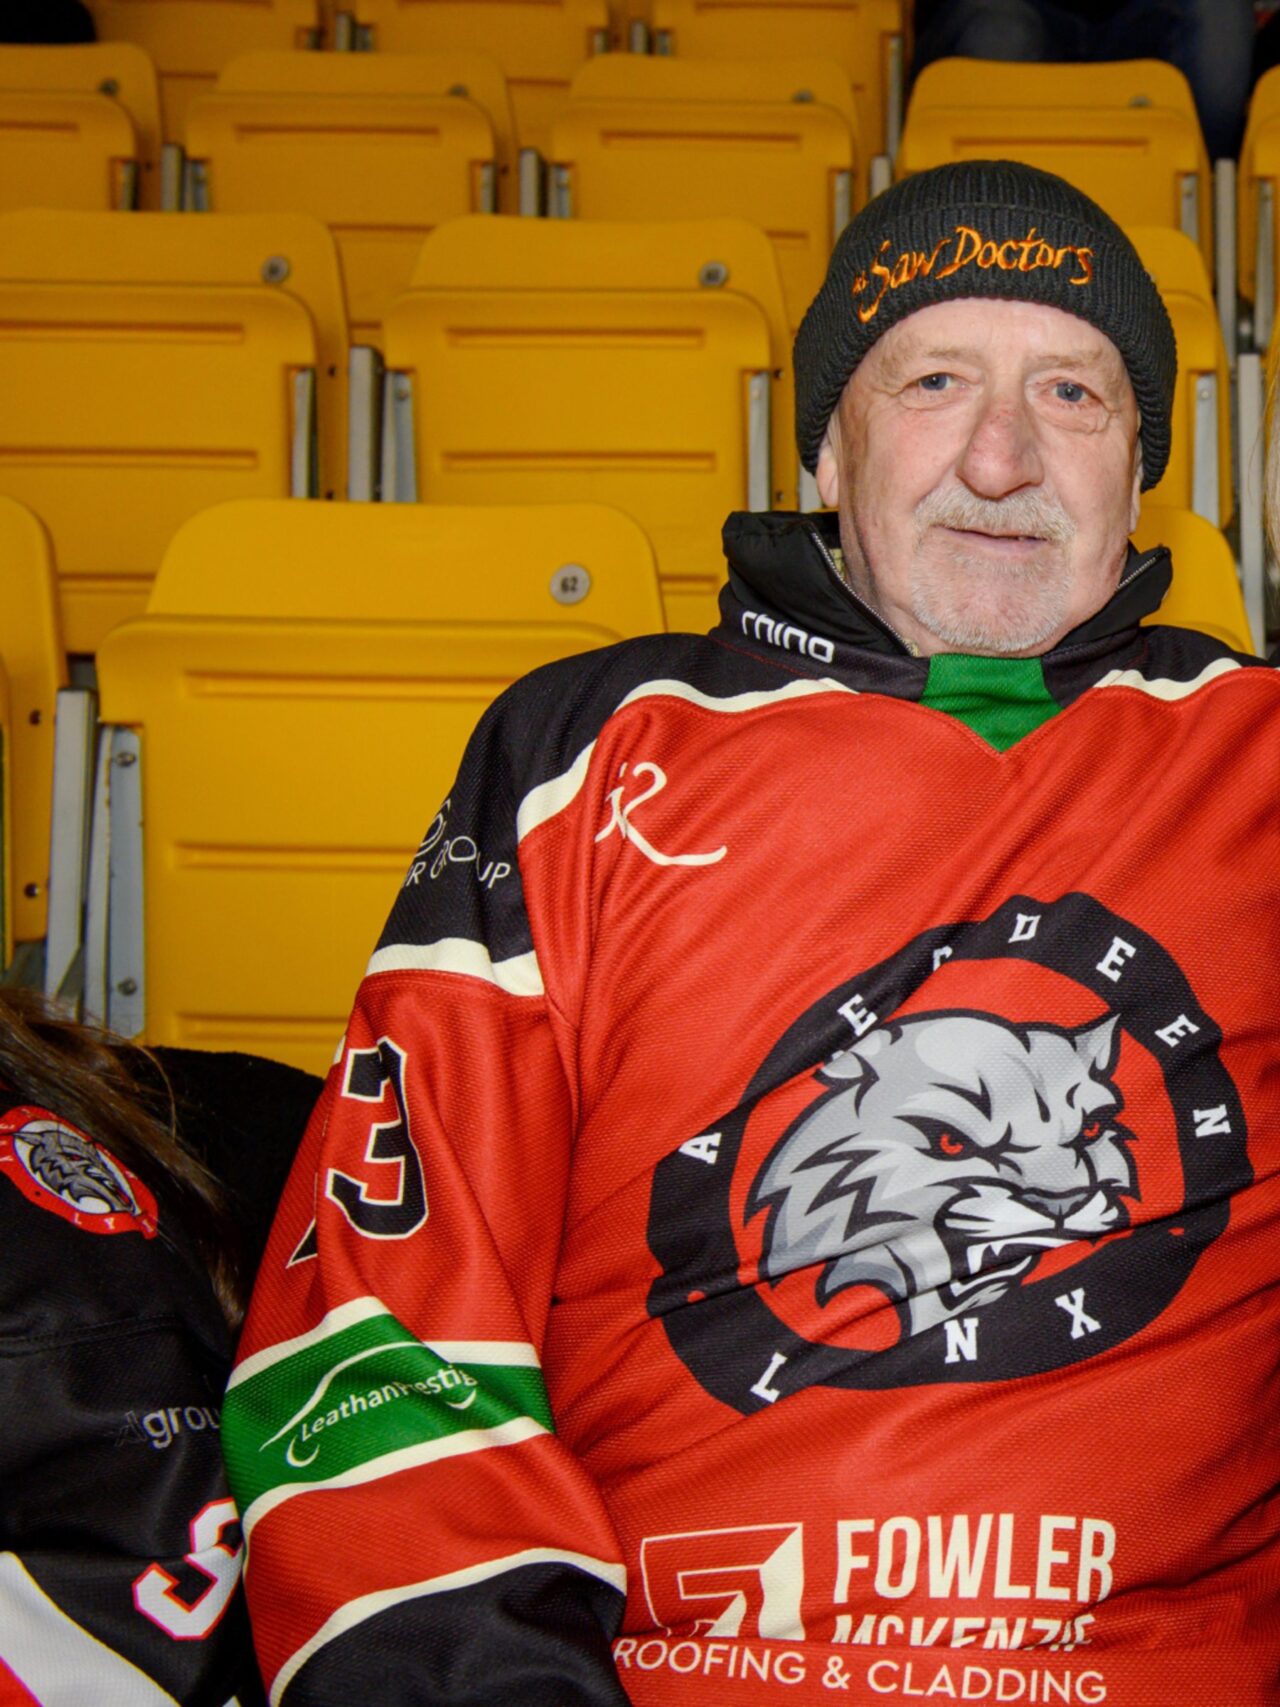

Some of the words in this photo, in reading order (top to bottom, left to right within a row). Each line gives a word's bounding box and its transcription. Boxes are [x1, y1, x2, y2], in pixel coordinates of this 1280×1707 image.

[858, 238, 951, 324] Saw
[935, 225, 1094, 286] Doctors
[741, 610, 835, 664] rhino
[679, 912, 1233, 1165] AEDEEN
[749, 1287, 1102, 1403] LNX
[832, 1513, 1117, 1604] FOWLER
[613, 1638, 807, 1685] ROOFING
[821, 1655, 851, 1690] &
[867, 1660, 1107, 1704] CLADDING
